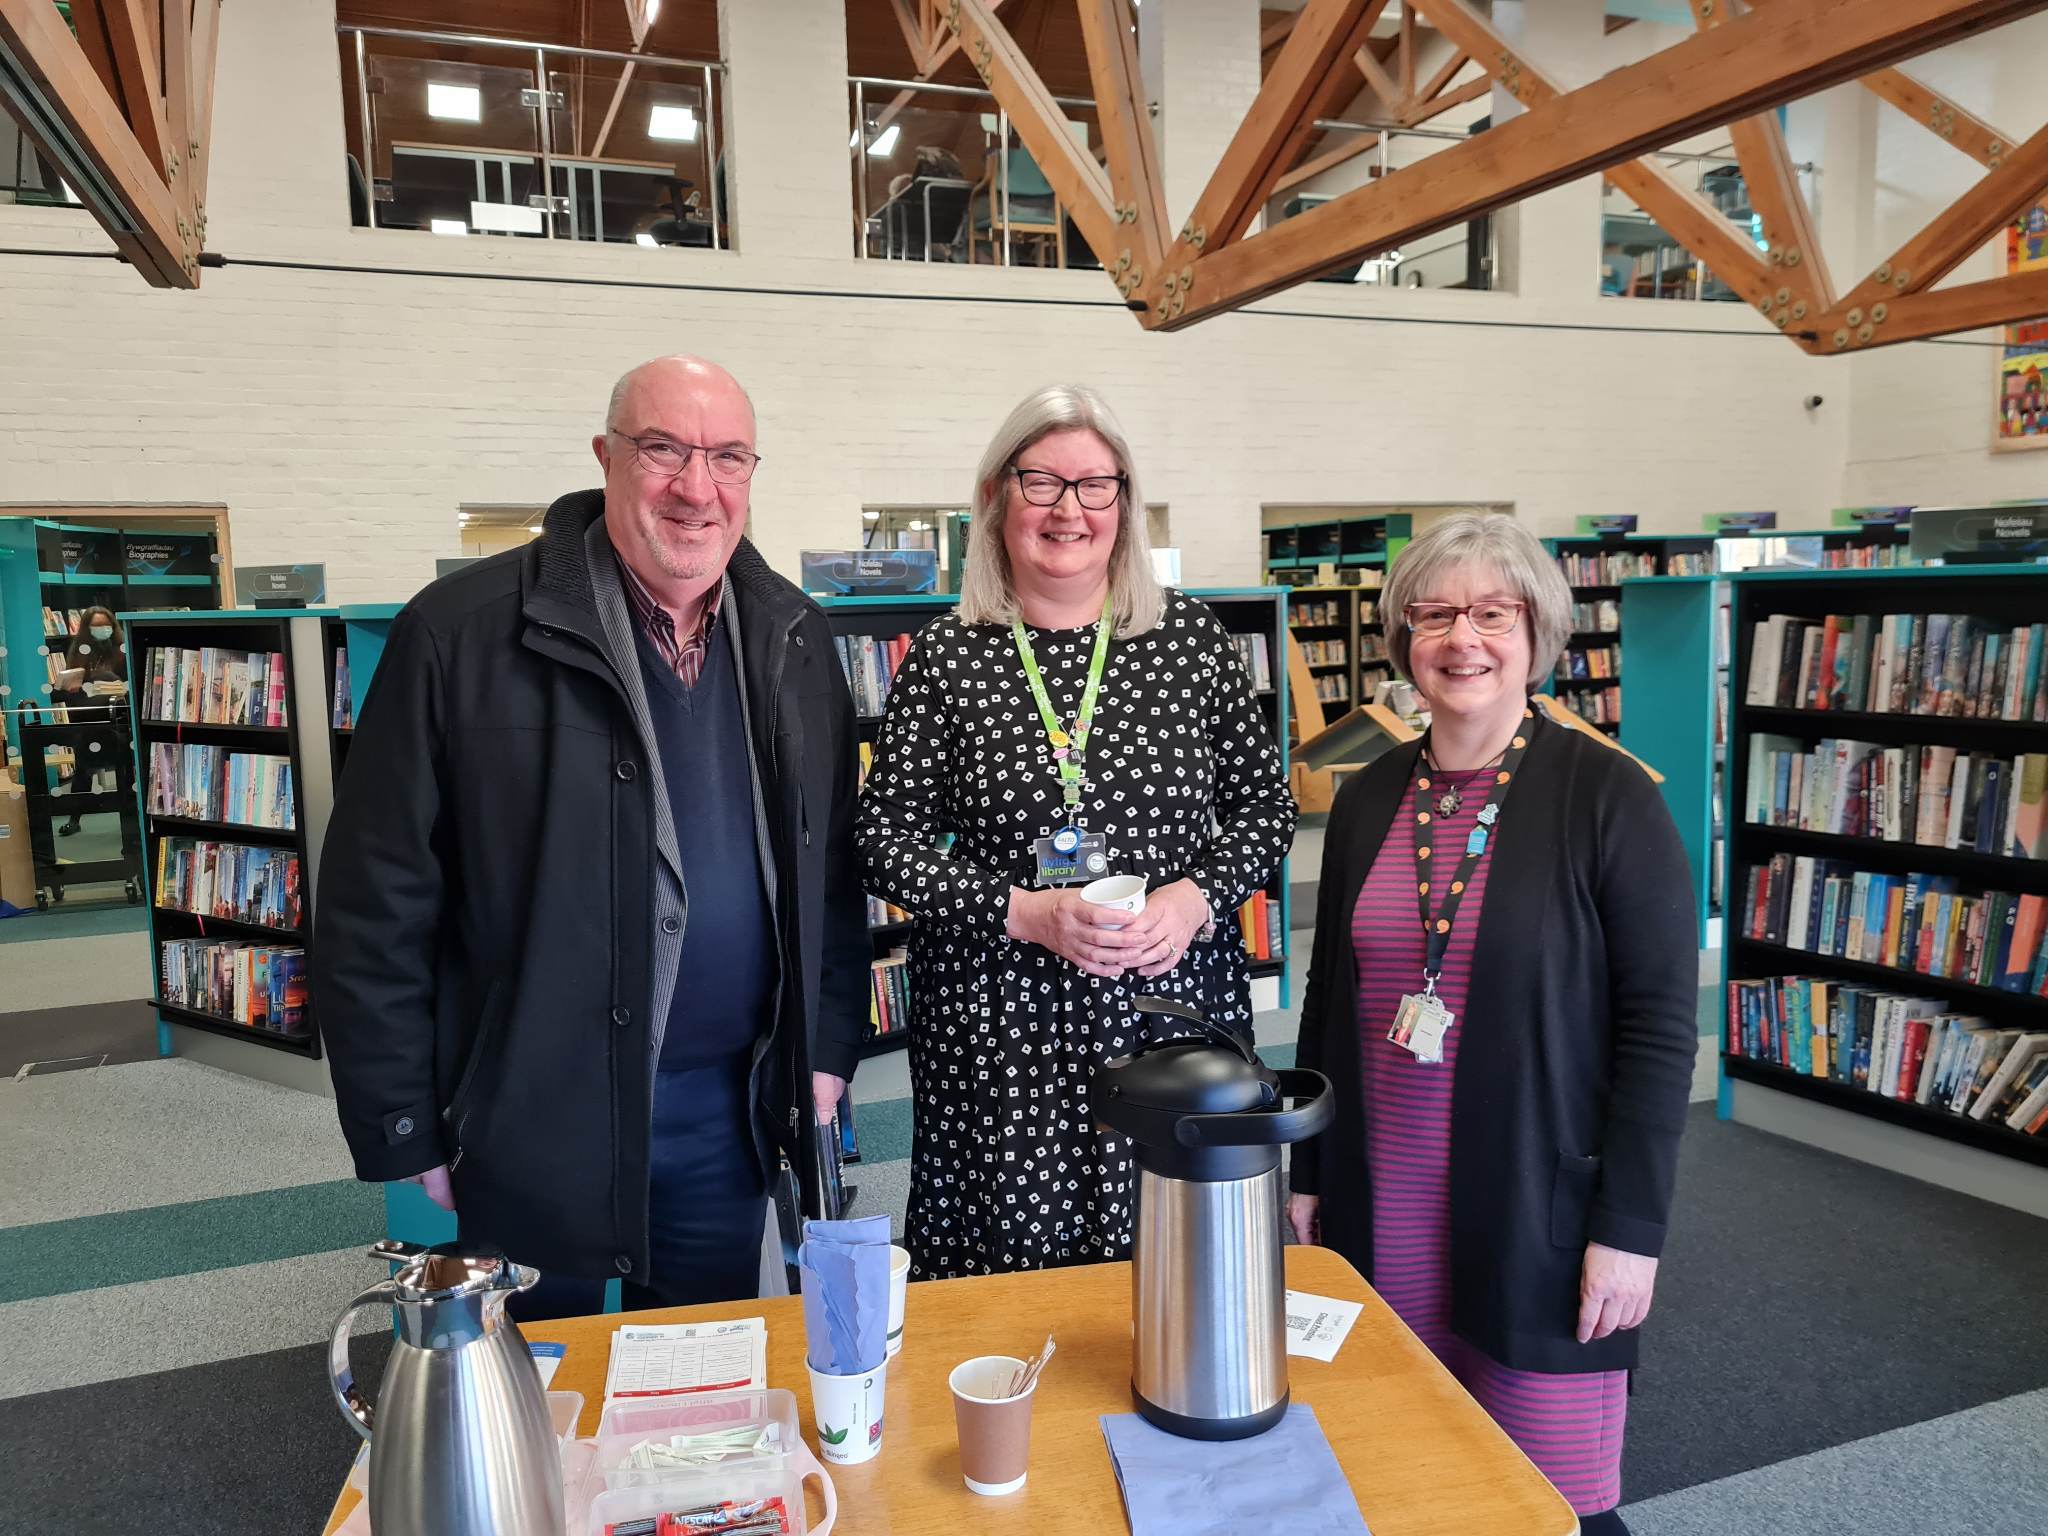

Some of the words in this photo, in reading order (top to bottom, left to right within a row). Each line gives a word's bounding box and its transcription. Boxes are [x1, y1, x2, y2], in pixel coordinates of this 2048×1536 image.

[1995, 527, 2031, 538] Novels
[128, 551, 169, 560] Biographies
[1041, 866, 1077, 877] library
